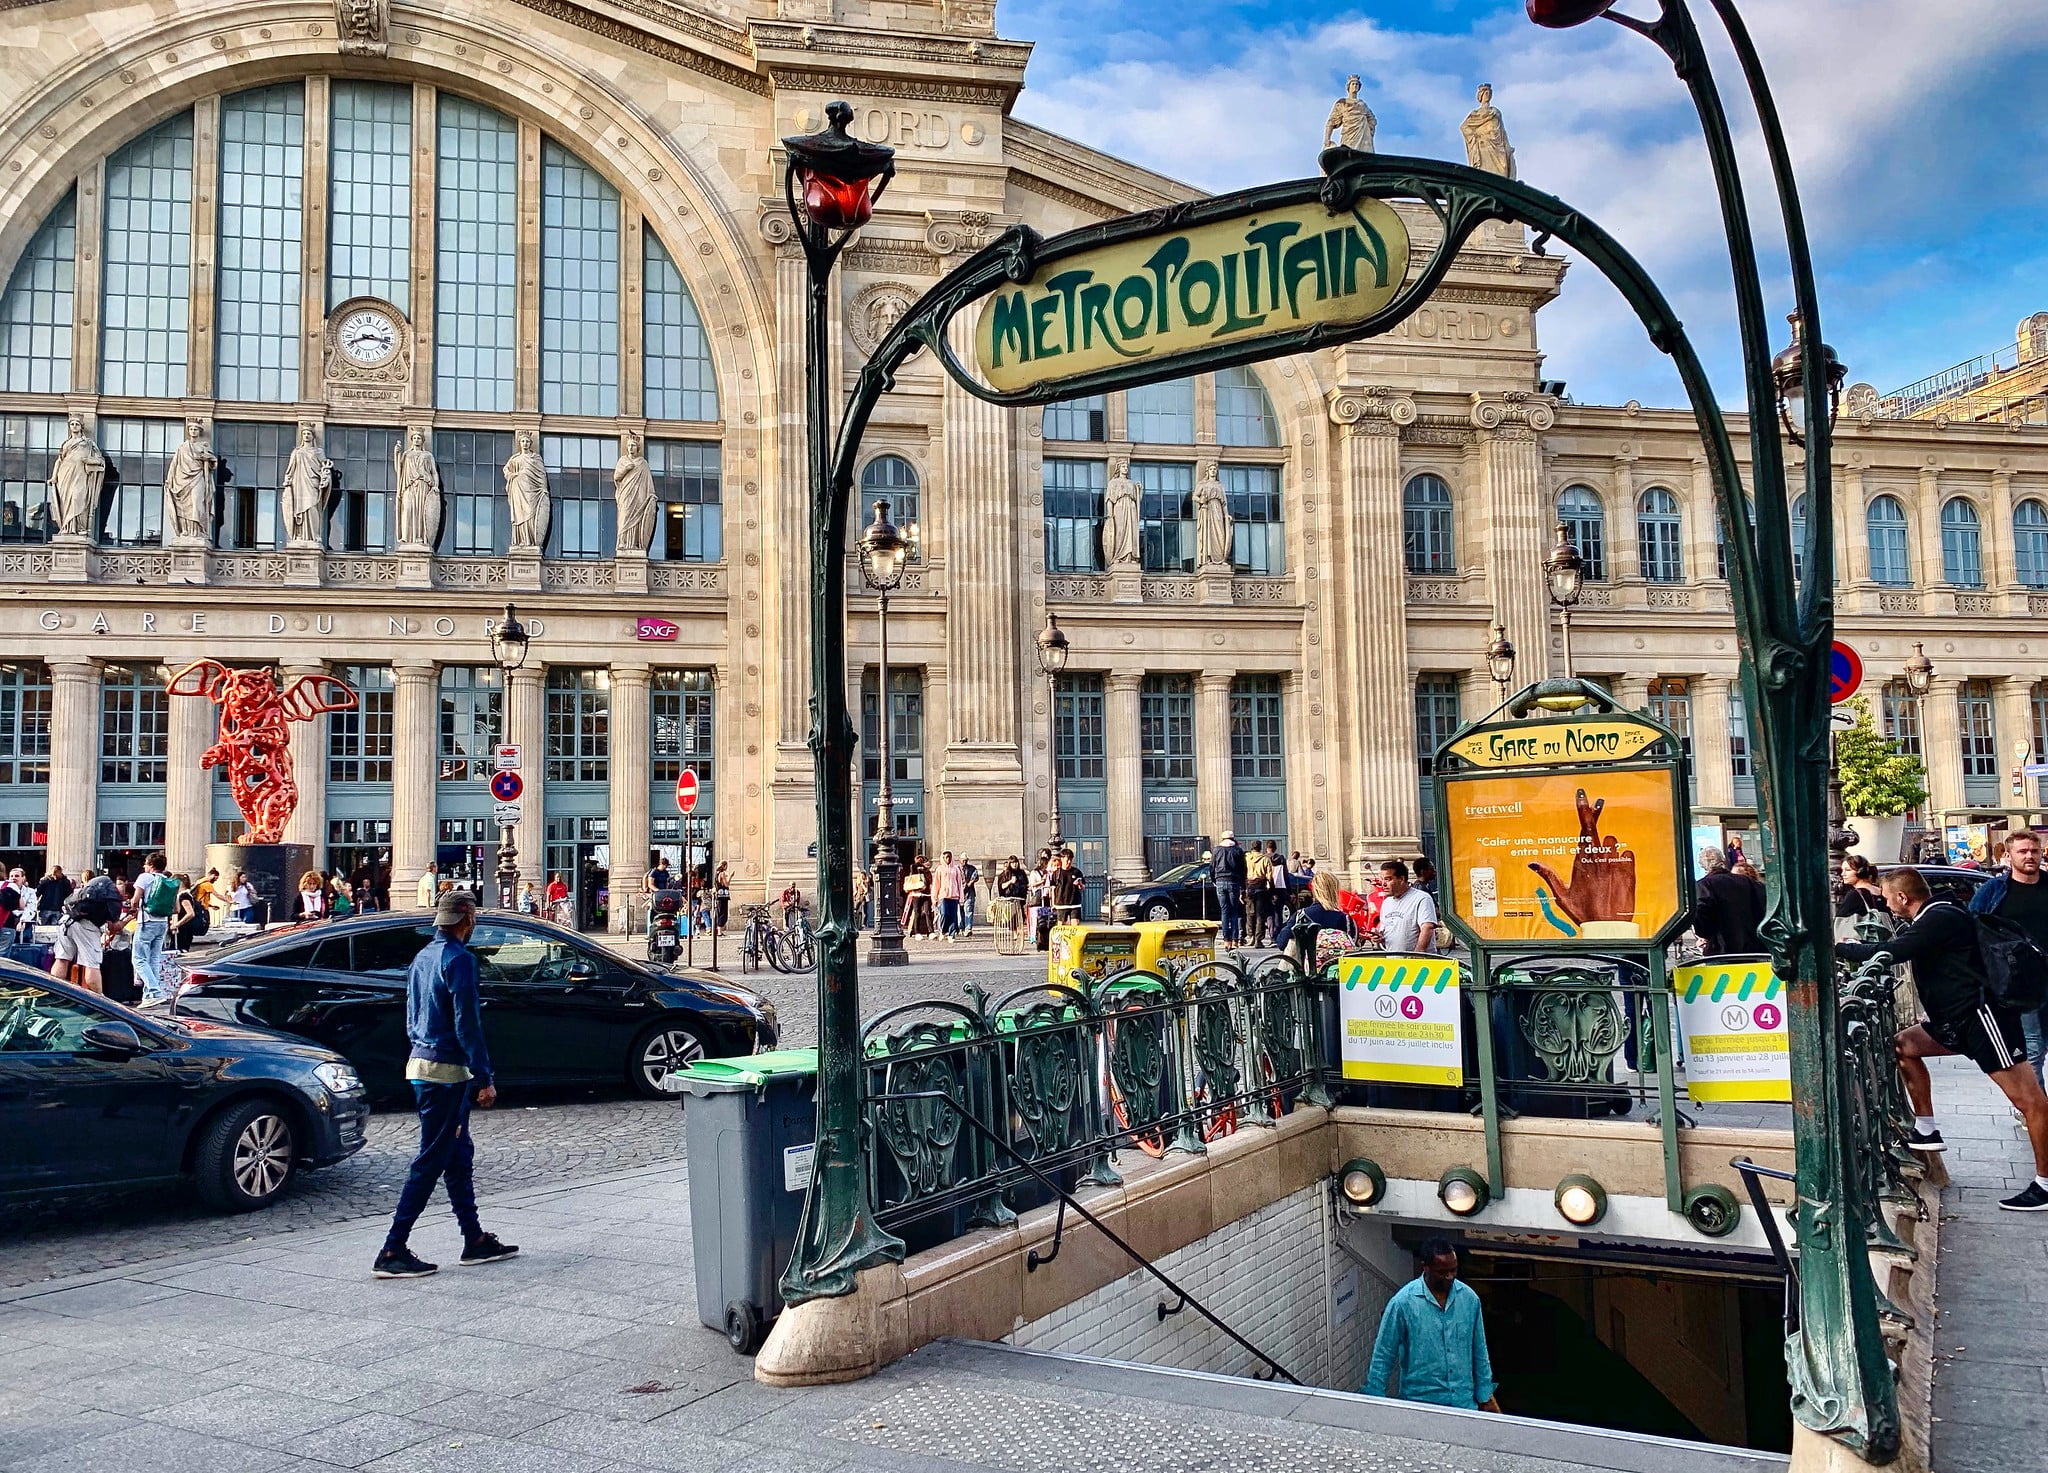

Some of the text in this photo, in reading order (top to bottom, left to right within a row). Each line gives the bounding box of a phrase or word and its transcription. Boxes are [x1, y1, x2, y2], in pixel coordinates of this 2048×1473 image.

[991, 208, 1390, 369] METROPOLITAIN
[39, 610, 545, 638] GARE DU NORD
[639, 625, 677, 637] SNCF
[1488, 728, 1619, 761] GARE DU NORD
[1465, 801, 1522, 815] treatwell
[1514, 838, 1534, 846] une
[1537, 835, 1592, 845] manucure
[1510, 848, 1539, 857] entre
[1543, 846, 1566, 856] midi
[1569, 846, 1580, 855] et
[1584, 844, 1612, 854] deux
[1347, 1019, 1454, 1032] Ligne fermée le soir du lundi
[1386, 1030, 1405, 1039] partir
[1407, 1030, 1417, 1038] de
[1419, 1031, 1444, 1040] 23h30
[1369, 1037, 1384, 1047] juin
[1397, 1039, 1406, 1047] 25
[1408, 1039, 1429, 1049] juillet
[1431, 1040, 1453, 1049] inclus
[1693, 1055, 1703, 1063] du
[1716, 1053, 1744, 1063] janvier
[1759, 1053, 1769, 1061] 28
